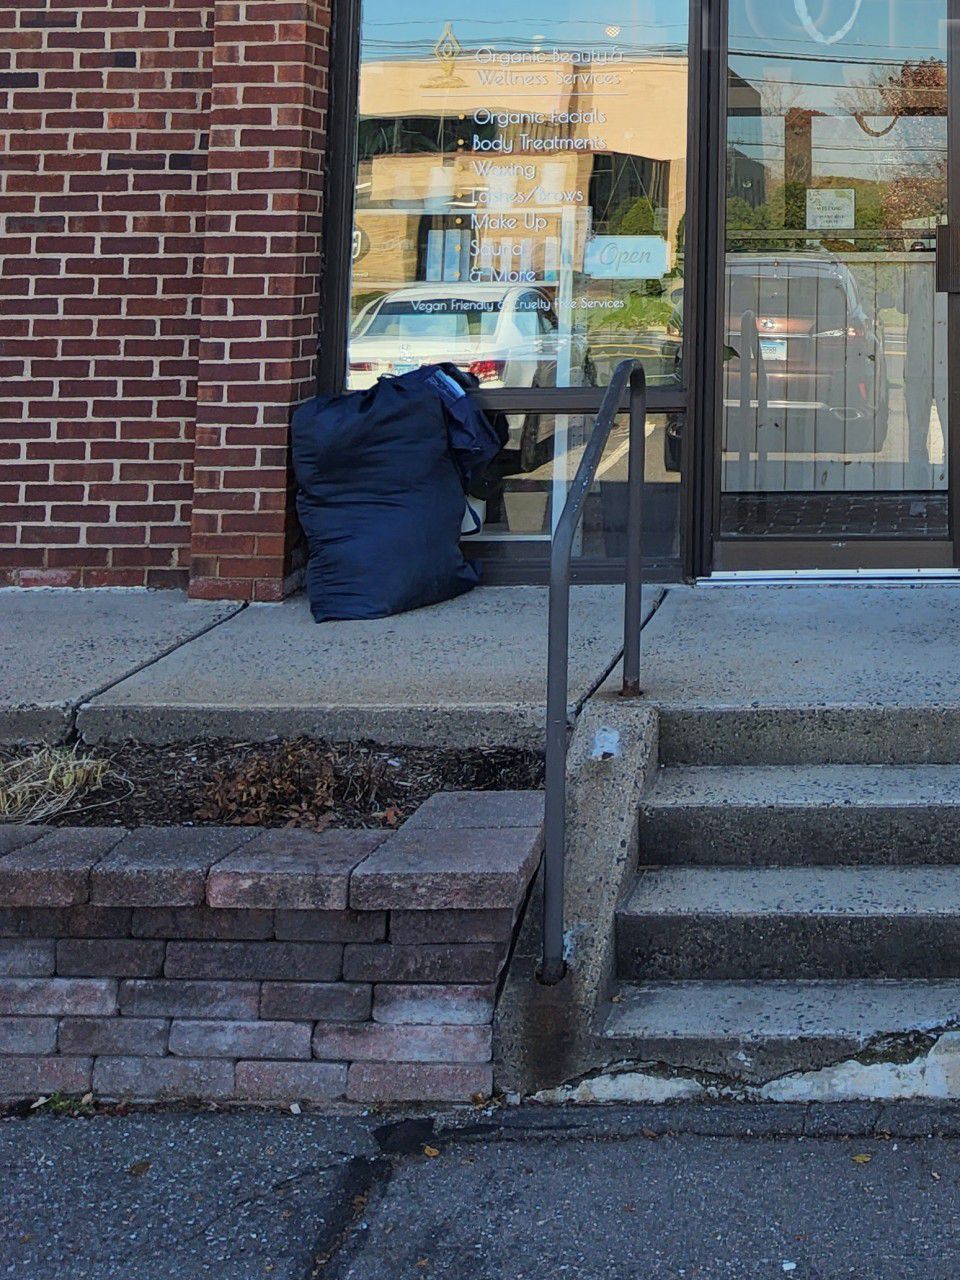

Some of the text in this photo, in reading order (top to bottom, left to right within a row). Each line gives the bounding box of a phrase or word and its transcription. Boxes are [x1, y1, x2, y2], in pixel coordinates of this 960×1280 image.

[475, 47, 546, 66] Organic
[552, 47, 608, 66] Beauty
[476, 69, 621, 86] Wellness Services
[473, 108, 607, 129] Organic Facials
[472, 134, 607, 153] Body Treatments
[472, 160, 536, 181] Waxing
[471, 185, 584, 203] Lashes/Brows
[471, 213, 548, 232] Make Up
[599, 241, 652, 270] Open
[469, 267, 537, 283] & More
[411, 299, 448, 314] Vegan
[451, 298, 494, 313] Friendly
[512, 297, 551, 313] Cruelty
[581, 297, 626, 310] Services
